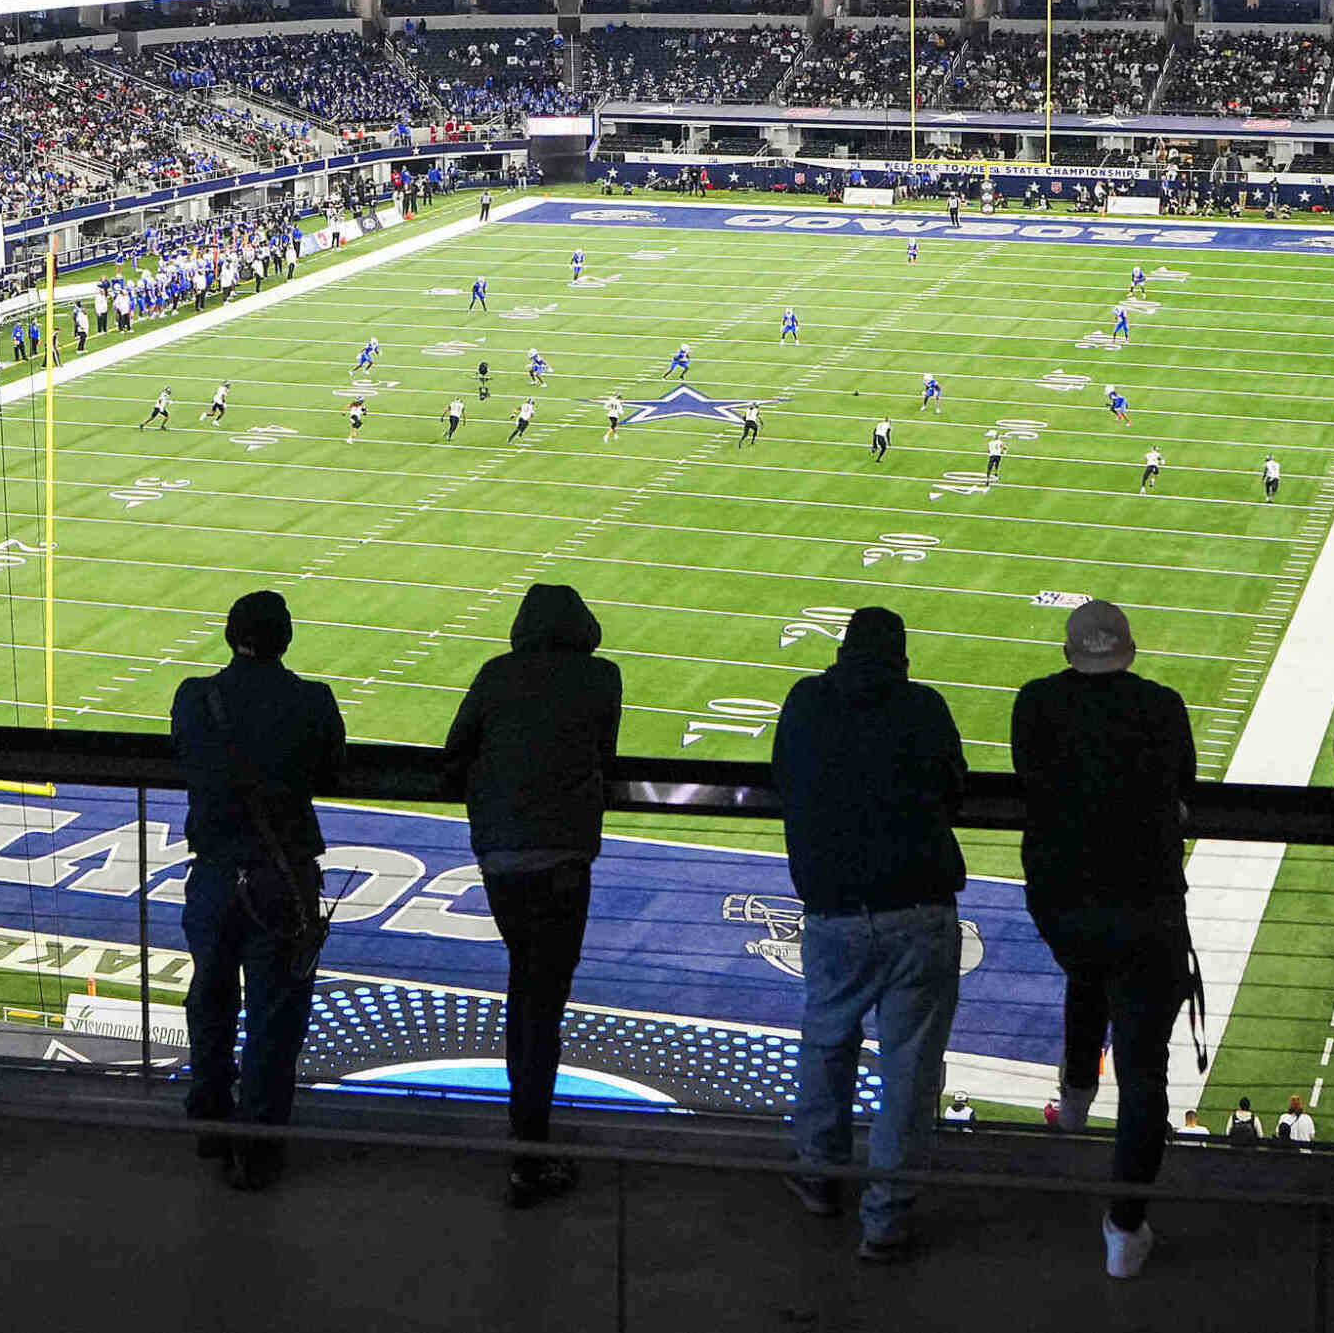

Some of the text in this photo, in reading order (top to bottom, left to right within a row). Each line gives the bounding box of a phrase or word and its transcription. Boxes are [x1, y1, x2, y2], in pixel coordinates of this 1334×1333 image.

[884, 161, 940, 173] WELCOME
[944, 162, 960, 172] TO
[963, 163, 985, 174] THE
[1005, 165, 1041, 176] STATE
[1045, 166, 1141, 179] CHAMPIONSHIPS
[723, 213, 1219, 245] COWBOYS
[862, 532, 942, 562] 30
[783, 606, 856, 642] 20
[686, 697, 782, 739] 10
